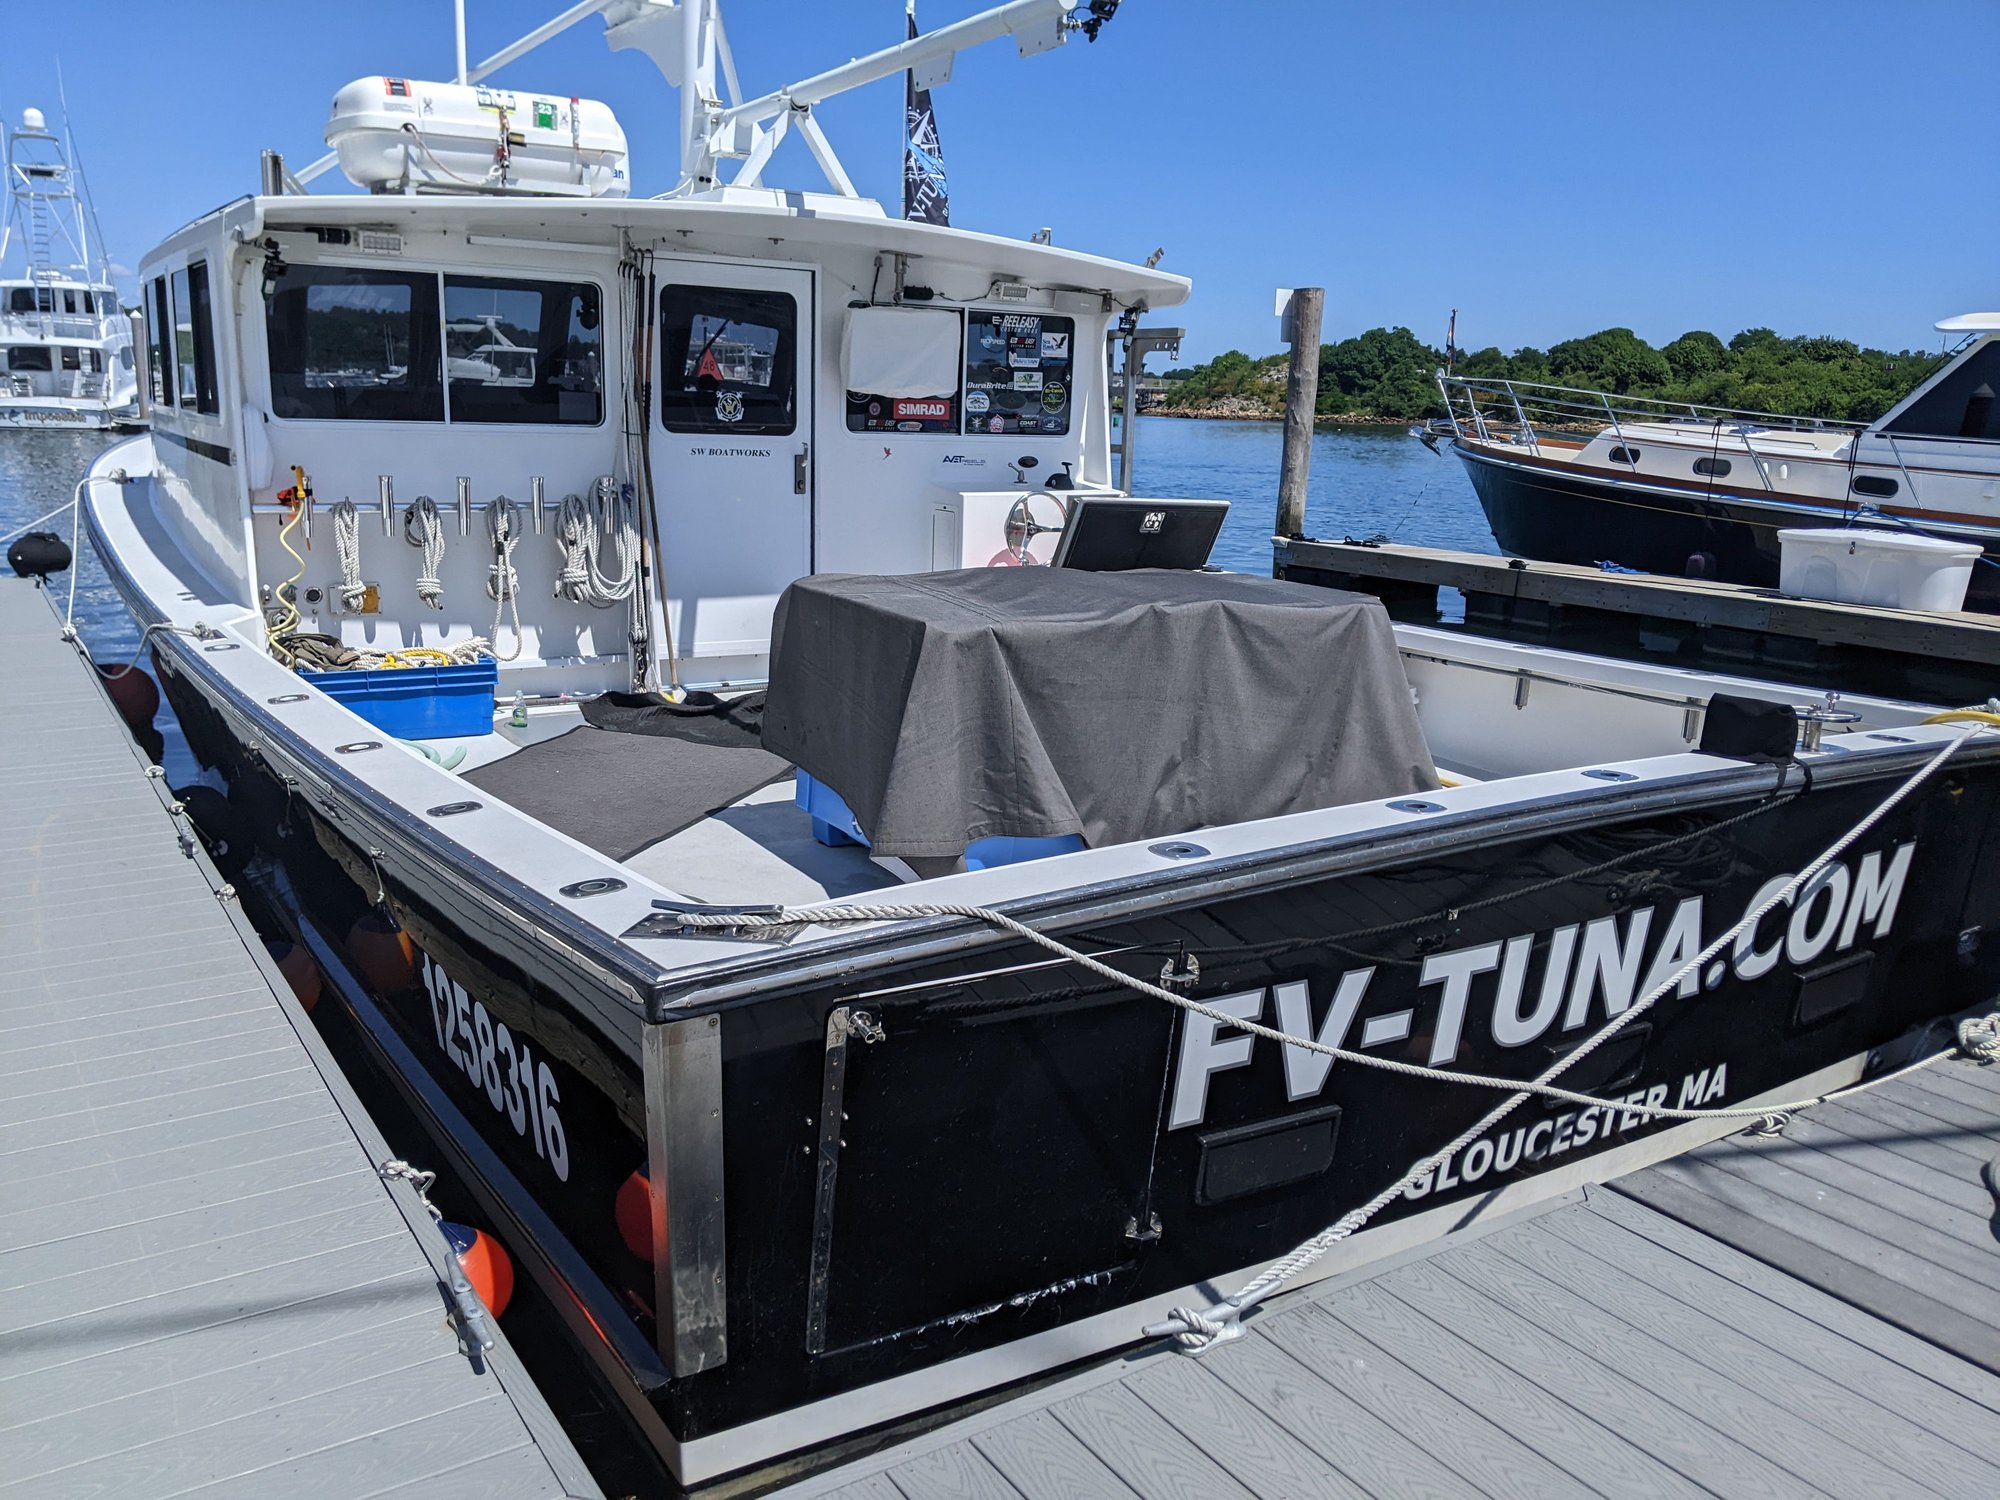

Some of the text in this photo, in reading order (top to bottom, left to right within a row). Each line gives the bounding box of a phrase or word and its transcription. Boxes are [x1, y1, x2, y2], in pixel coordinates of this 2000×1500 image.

[538, 104, 553, 115] 23
[1003, 315, 1040, 329] REELEASY
[966, 381, 1007, 390] DuraBrite
[898, 403, 946, 415] SIMRAD
[690, 447, 771, 457] SW BOATWORKS
[1167, 841, 1917, 1131] FV-TUNA.COM
[422, 951, 569, 1183] 1258316
[1402, 1062, 1727, 1200] GLOUCESTER MA
